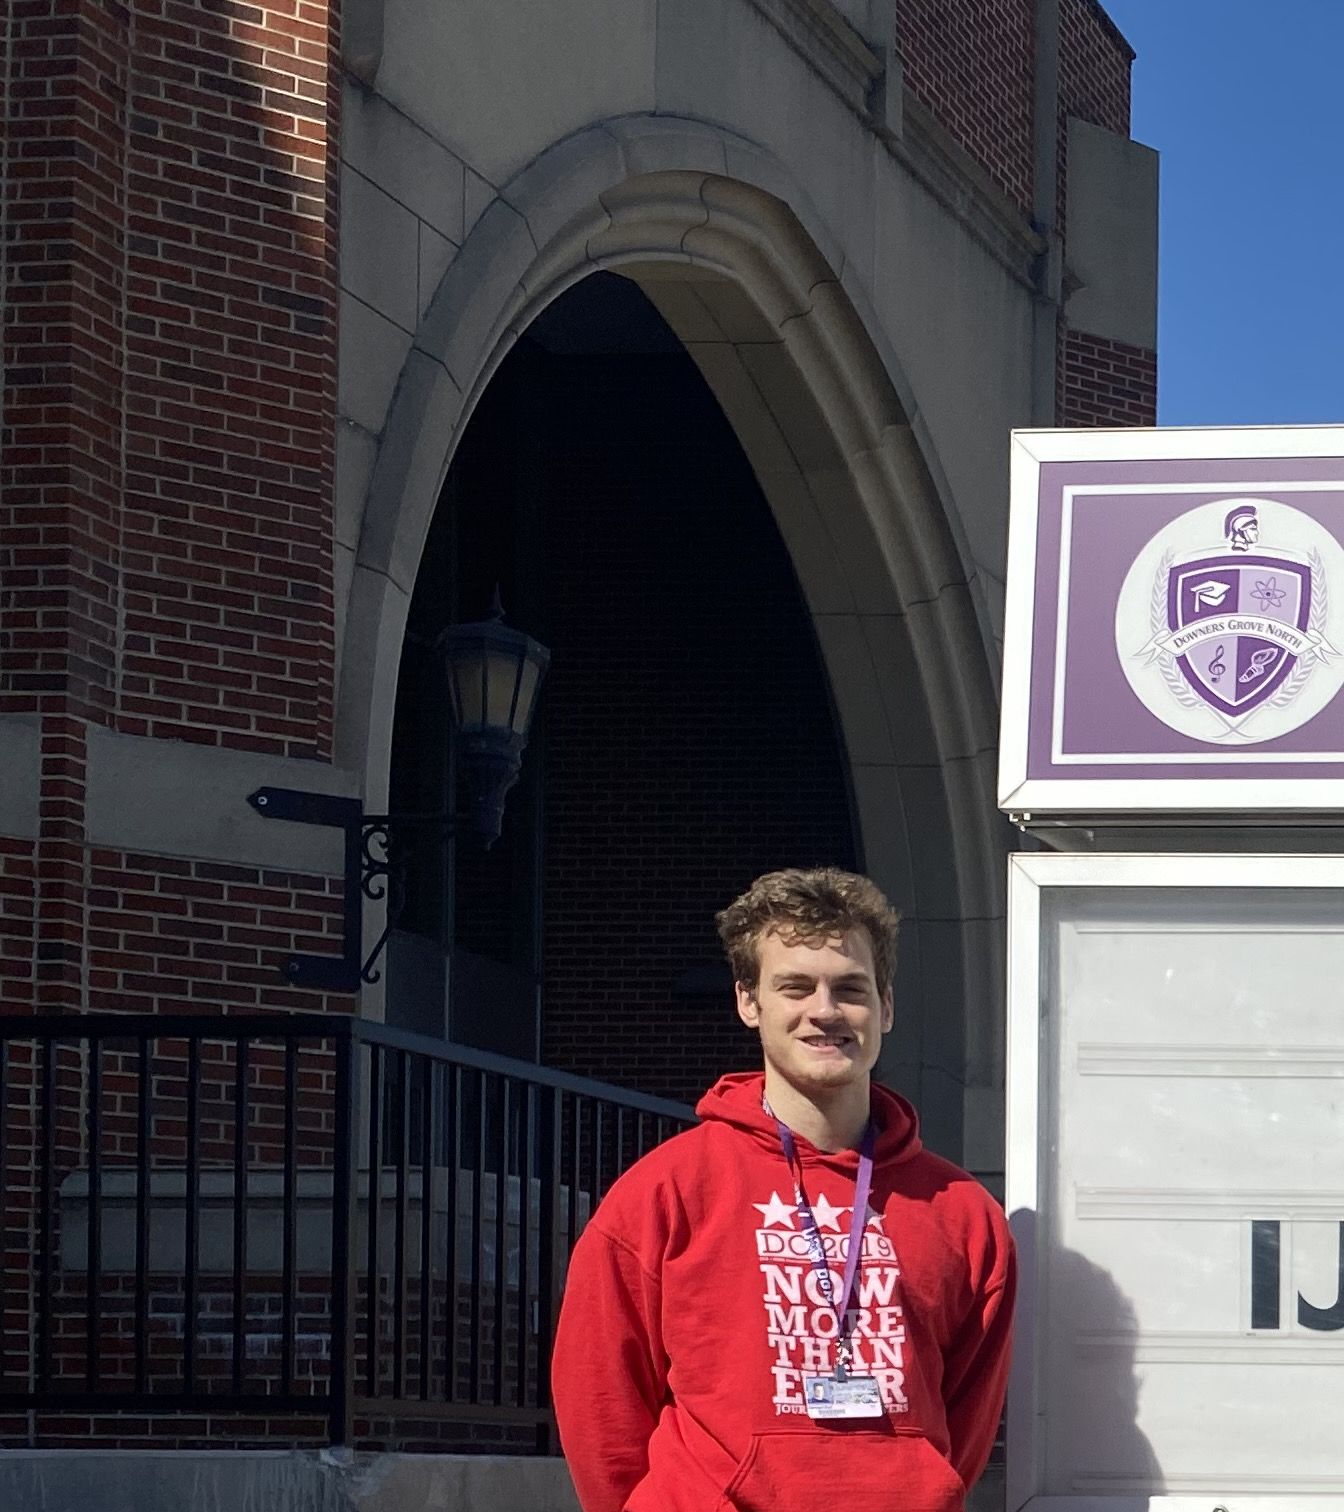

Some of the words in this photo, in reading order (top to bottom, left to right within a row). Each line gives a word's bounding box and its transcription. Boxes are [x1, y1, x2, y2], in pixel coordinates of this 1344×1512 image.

[760, 1264, 900, 1308] NOW
[764, 1303, 905, 1339] MORE
[771, 1366, 909, 1405] ER
